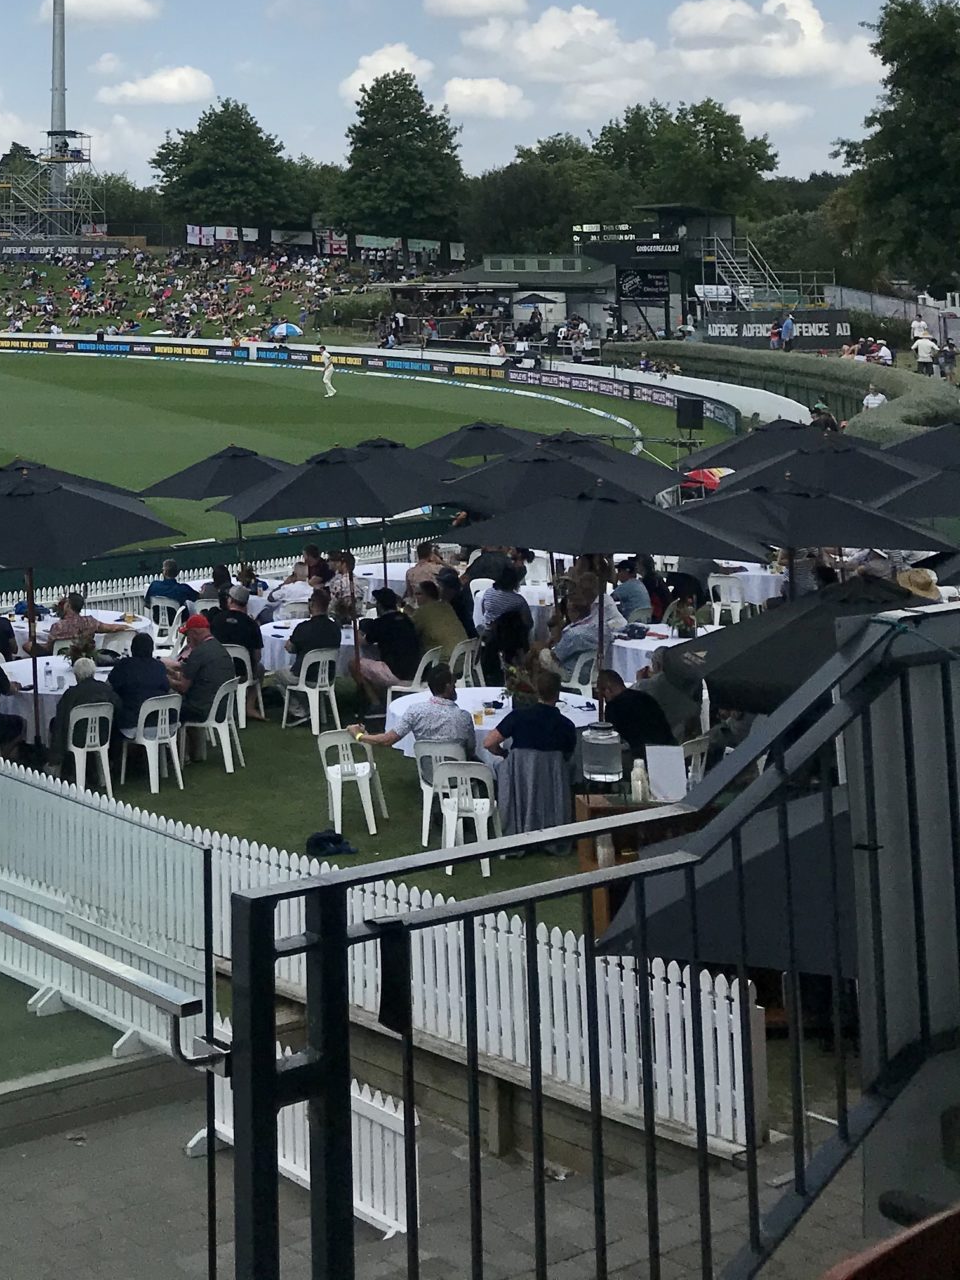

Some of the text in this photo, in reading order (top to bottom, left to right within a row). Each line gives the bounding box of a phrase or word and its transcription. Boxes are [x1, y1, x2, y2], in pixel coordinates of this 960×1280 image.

[708, 323, 850, 336] ADFENCE ADFENC DFENCE AD
